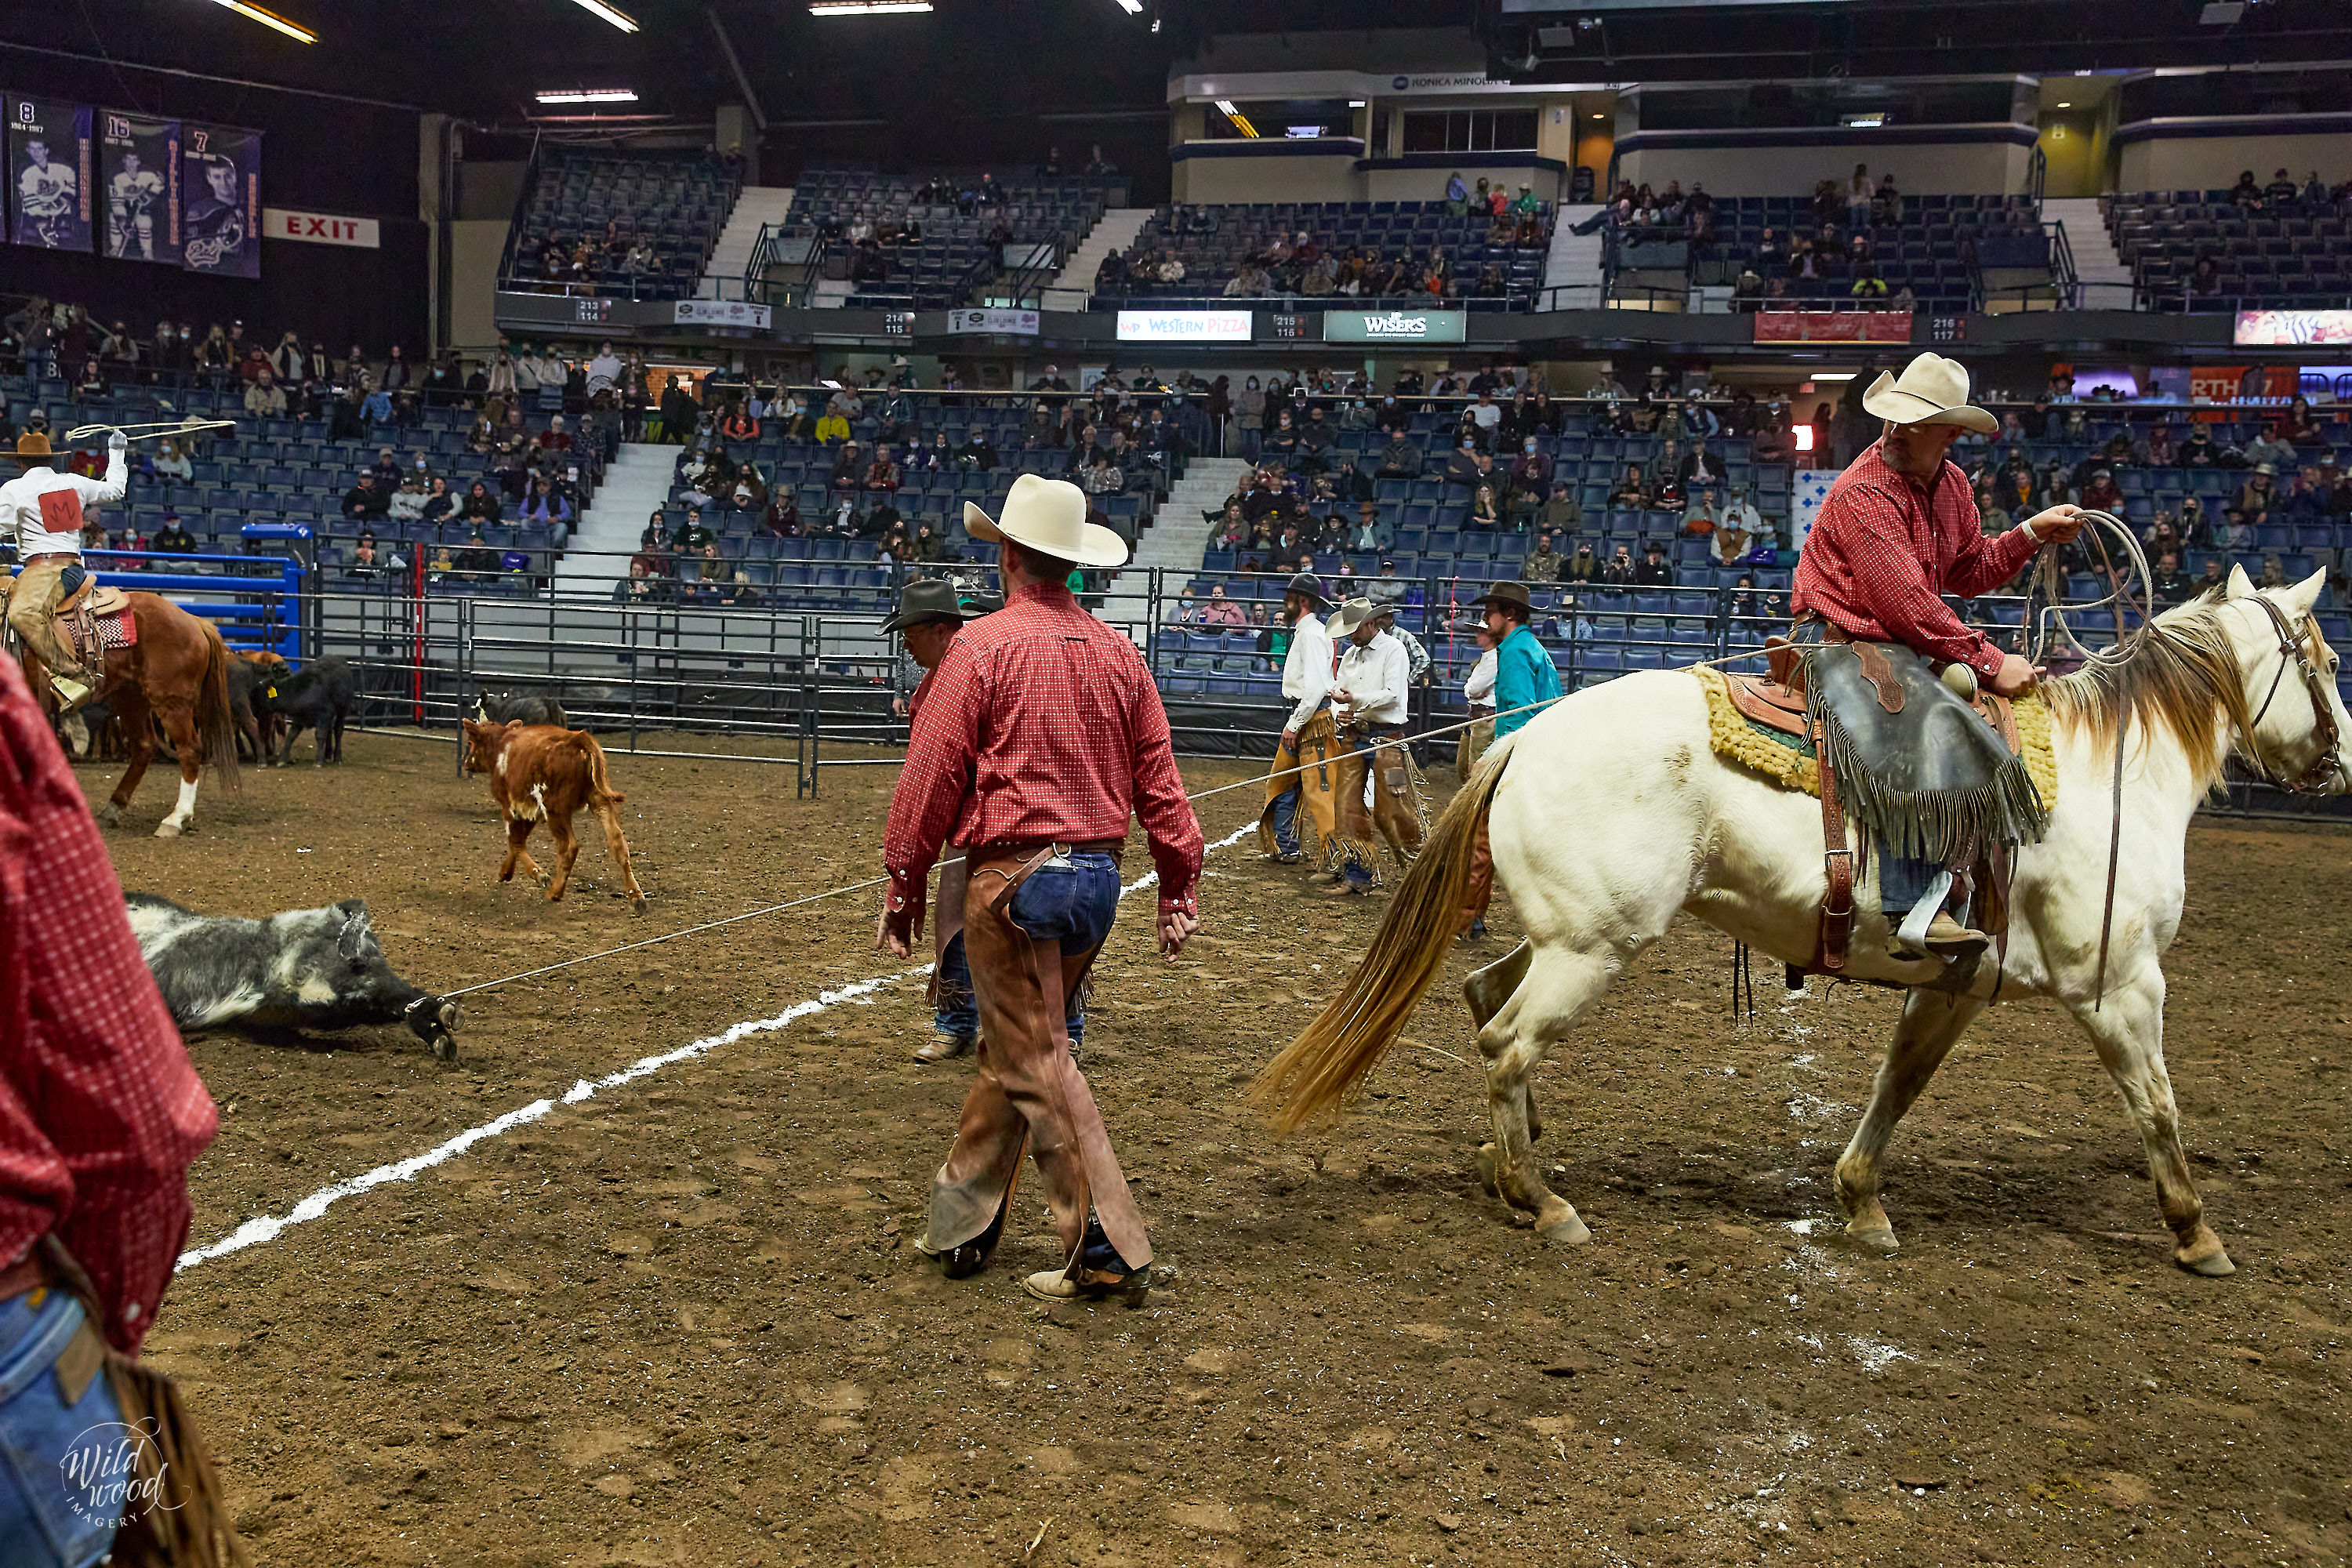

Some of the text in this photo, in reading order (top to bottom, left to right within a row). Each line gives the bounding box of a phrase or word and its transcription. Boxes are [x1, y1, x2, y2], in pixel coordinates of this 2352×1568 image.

[1412, 78, 1450, 87] KONICA
[20, 102, 34, 123] 8
[108, 117, 129, 138] 16
[194, 131, 208, 152] 7
[287, 216, 358, 240] EXIT
[580, 301, 598, 310] 213
[1149, 318, 1203, 333] WESTERN
[1277, 317, 1294, 325] 215
[1933, 319, 1955, 328] 216
